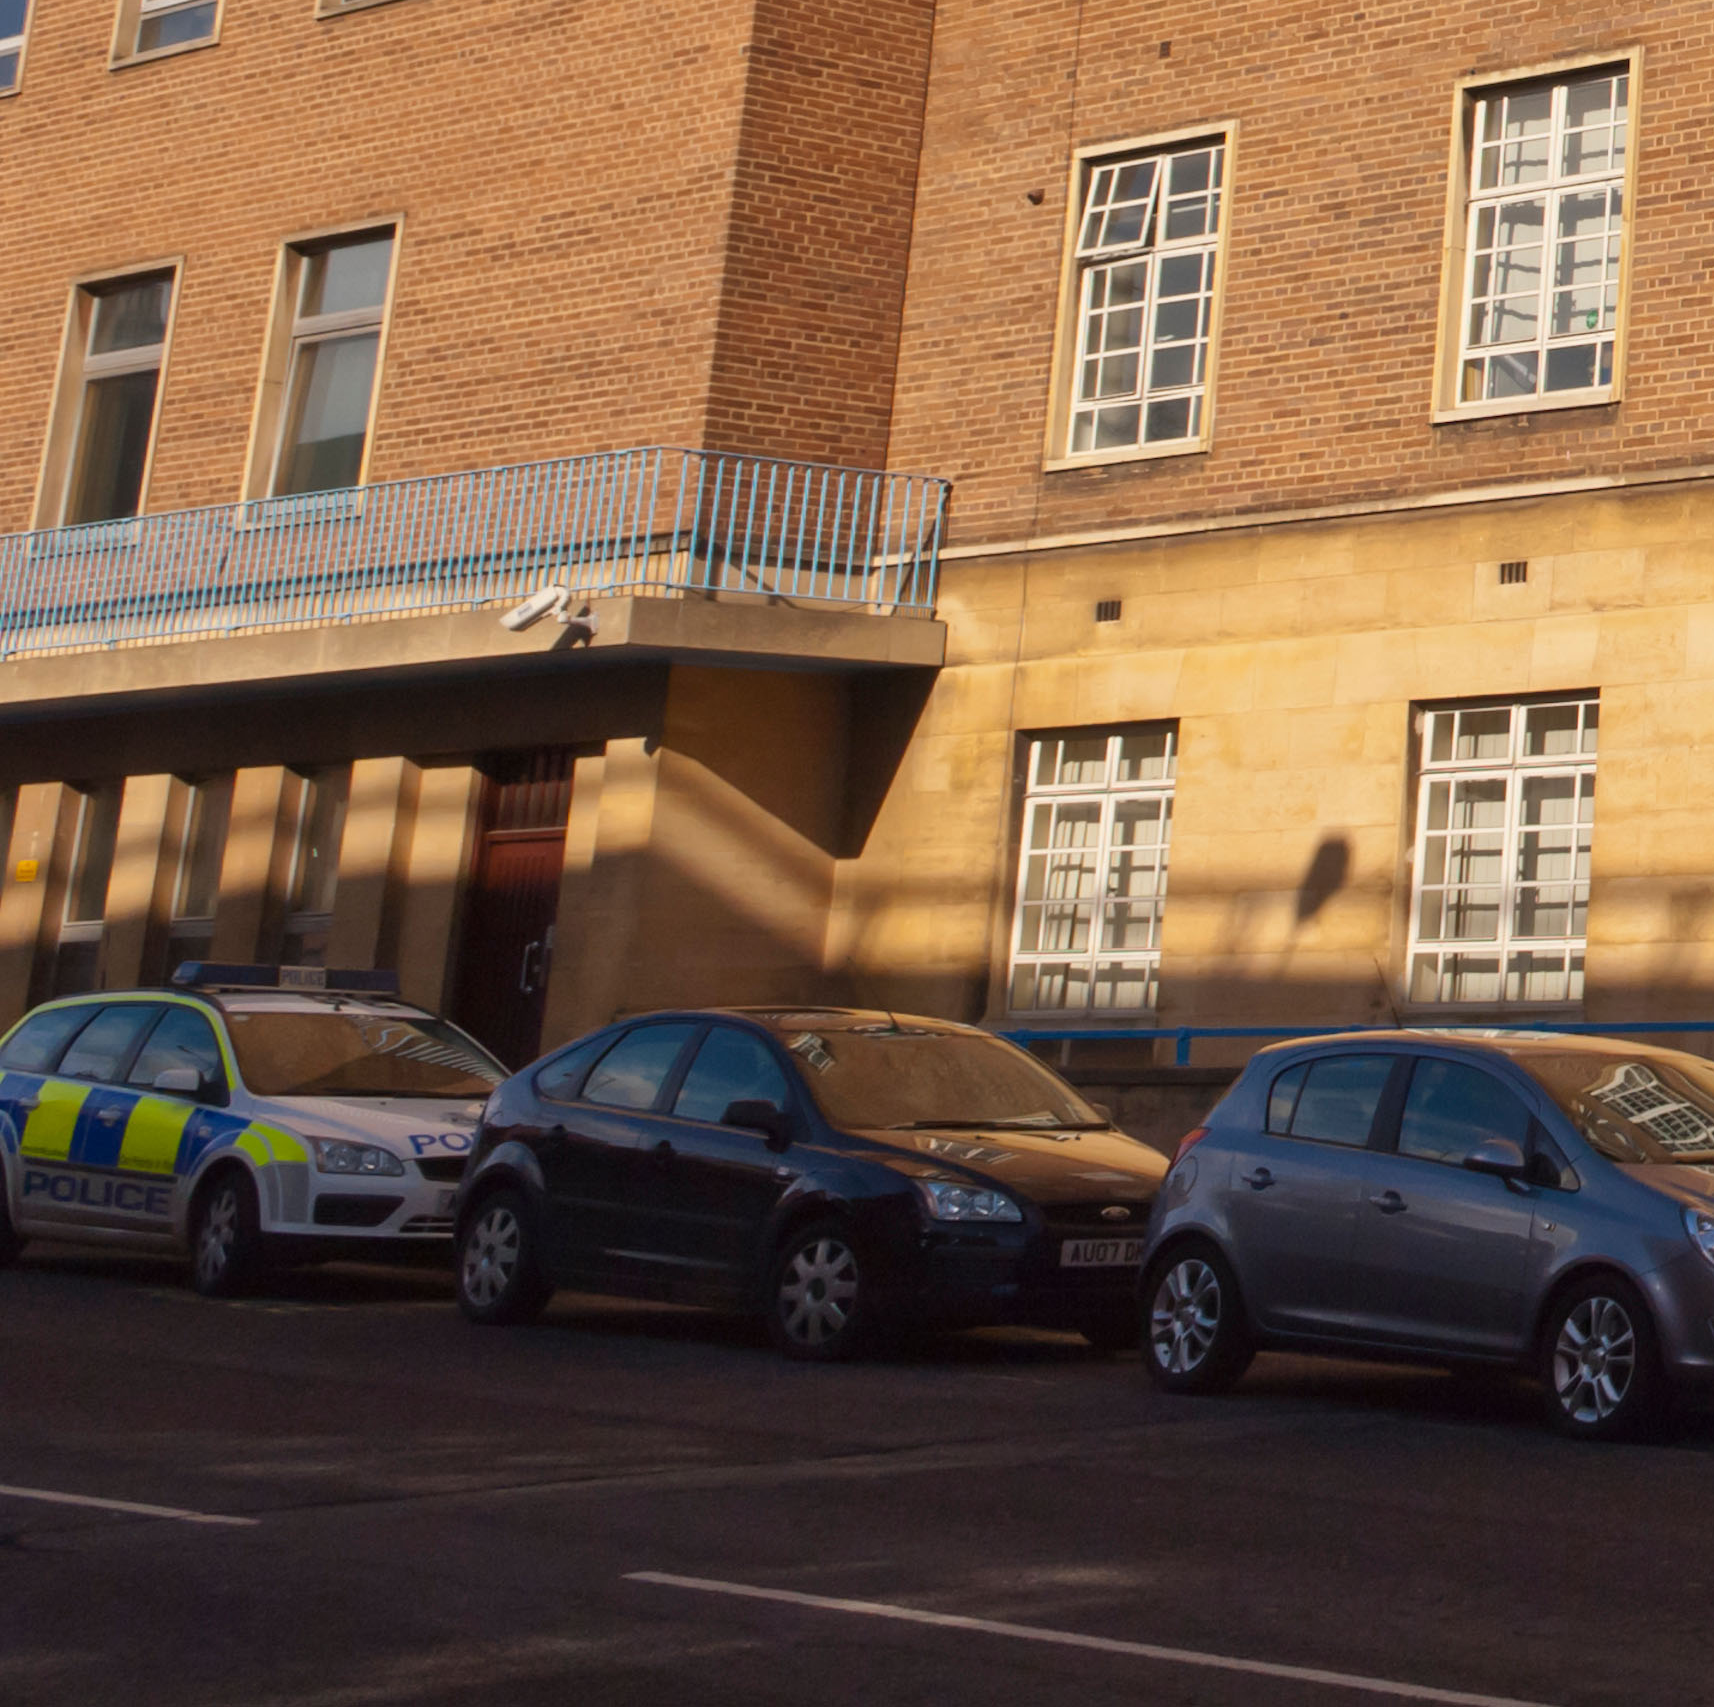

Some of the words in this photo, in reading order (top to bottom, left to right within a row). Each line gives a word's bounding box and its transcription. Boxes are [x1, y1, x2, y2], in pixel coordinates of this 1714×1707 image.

[282, 970, 324, 986] POLICE
[408, 1133, 474, 1155] PO
[24, 1170, 172, 1215] POLICE
[1070, 1242, 1120, 1263] AU07
